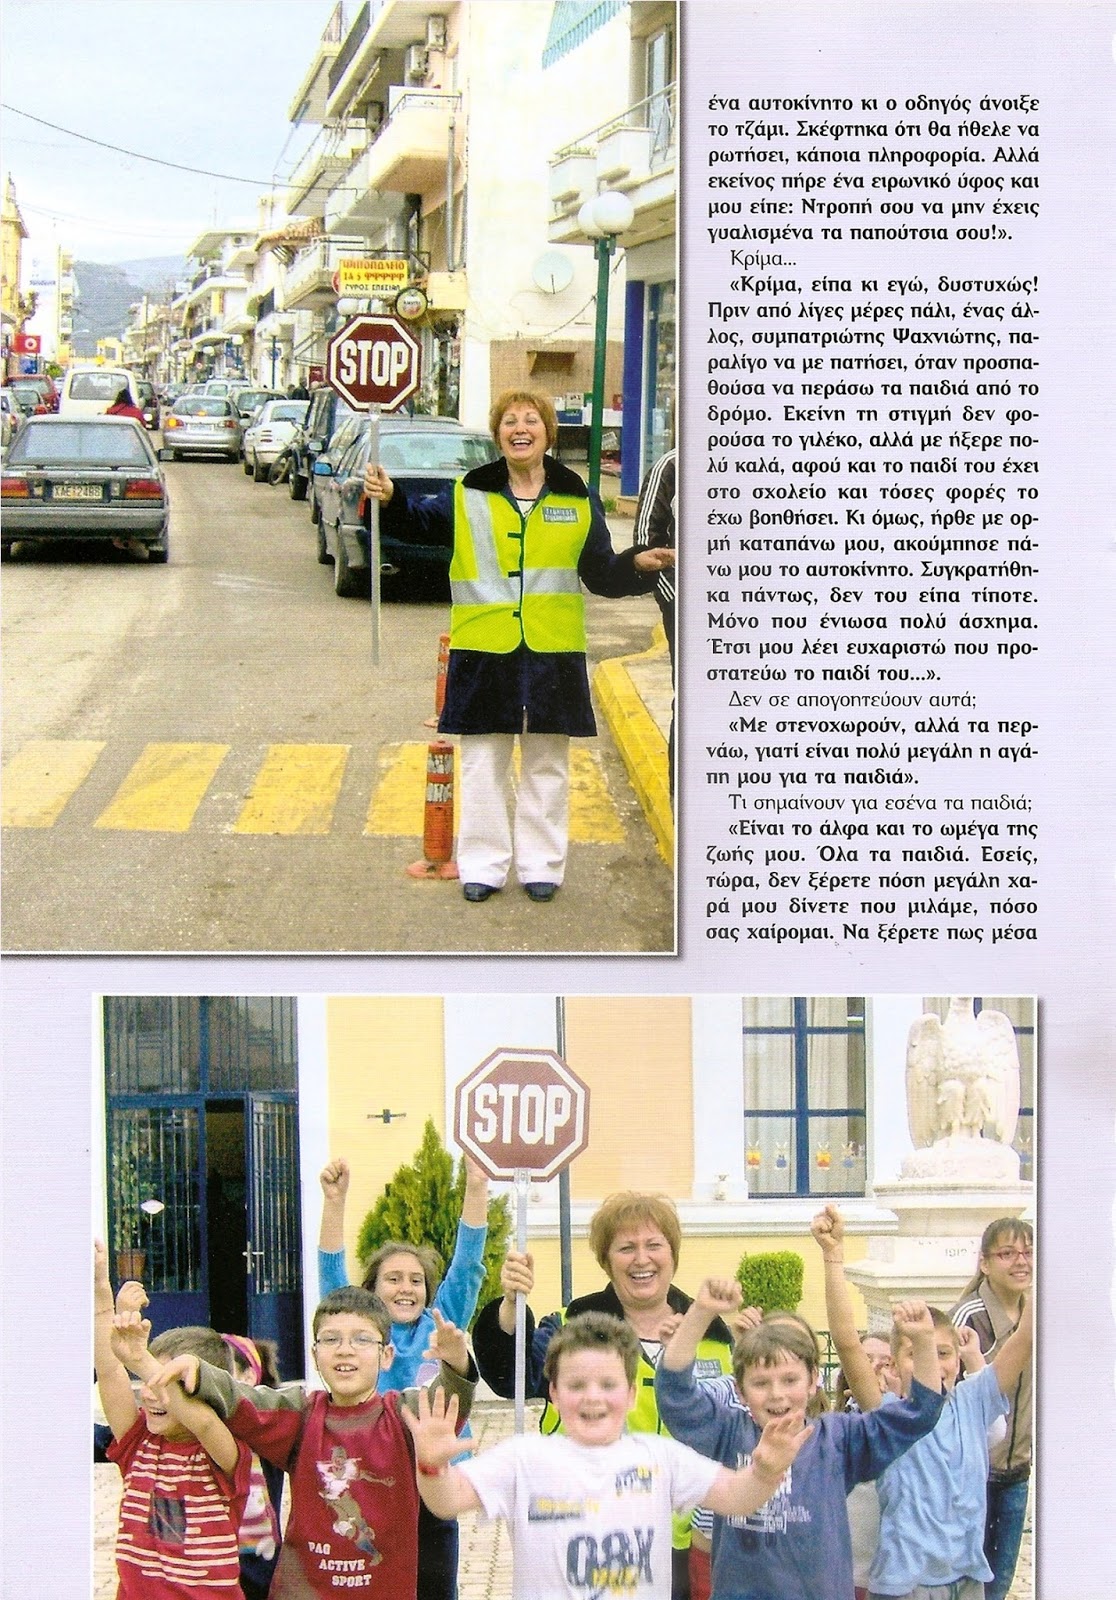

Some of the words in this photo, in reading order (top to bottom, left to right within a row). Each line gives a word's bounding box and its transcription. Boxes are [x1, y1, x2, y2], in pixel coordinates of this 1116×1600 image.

[708, 93, 741, 111] ένα
[748, 94, 854, 111] αυτοκίνητο
[860, 98, 878, 111] κι
[885, 98, 898, 111] ο
[904, 94, 972, 115] οδηγός
[979, 94, 1040, 115] άνοιξε
[708, 145, 790, 167] ρωτήσει,
[796, 145, 861, 163] κάποια
[867, 146, 986, 168] πληροφορία.
[992, 146, 1040, 163] Αλλά
[707, 172, 776, 192] εκείνος
[781, 171, 827, 193] πήρε
[832, 171, 865, 189] ένα
[871, 172, 951, 193] ειρωνικό
[957, 172, 1005, 193] ύφος
[1010, 176, 1040, 189] και
[706, 223, 814, 245] γυαλισμένα
[820, 228, 843, 240] τα
[849, 223, 949, 241] παπούτσια
[955, 223, 1013, 241] σου!».
[730, 249, 797, 271] Κρίμα...
[730, 275, 803, 297] «Κρίμα,
[811, 275, 853, 292] είπα
[860, 279, 879, 292] κι
[887, 275, 929, 296] εγώ,
[937, 275, 1038, 296] δυστυχώς!
[706, 327, 744, 348] λος,
[751, 327, 885, 349] συμπατριώτης
[892, 327, 1001, 348] Ψαχνιώτης,
[1008, 332, 1040, 344] πα-
[339, 339, 409, 387] STOP
[707, 353, 768, 374] ραλίγο
[773, 357, 796, 370] να
[802, 357, 824, 374] με
[829, 353, 908, 373] πατήσει,
[914, 353, 958, 370] όταν
[962, 357, 1040, 374] προσπα-
[707, 404, 772, 426] δρόμο.
[783, 404, 845, 422] Εκείνη
[856, 409, 878, 422] τη
[888, 404, 952, 426] στιγμή
[962, 405, 996, 422] δεν
[1005, 409, 1040, 426] φο-
[707, 430, 766, 452] ρούσα
[771, 435, 793, 447] το
[798, 430, 863, 452] γιλέκο,
[869, 430, 914, 448] αλλά
[920, 435, 943, 452] με
[948, 430, 1003, 452] ήξερε
[1008, 435, 1039, 448] πο-
[707, 487, 741, 500] στο
[752, 482, 827, 500] σχολείο
[837, 487, 868, 500] και
[879, 482, 935, 503] τόσες
[945, 482, 1006, 504] φορές
[1016, 487, 1039, 500] το
[707, 508, 743, 526] έχω
[749, 508, 839, 530] βοηθήσει.
[845, 509, 866, 526] Κι
[871, 508, 925, 530] όμως,
[930, 508, 976, 530] ήρθε
[982, 513, 1004, 530] με
[1009, 513, 1039, 530] ορ-
[707, 534, 731, 556] μή
[739, 534, 836, 551] καταπάνω
[844, 539, 885, 556] μου,
[893, 534, 1000, 556] ακούμπησε
[1007, 534, 1039, 552] πά-
[706, 590, 730, 603] κα
[740, 586, 818, 607] πάντως,
[829, 586, 864, 603] δεν
[874, 590, 907, 603] του
[918, 586, 961, 603] είπα
[971, 586, 1038, 603] τίποτε.
[706, 638, 751, 655] Έτσι
[759, 642, 794, 660] μου
[801, 638, 839, 655] λέει
[846, 638, 946, 660] ευχαριστώ
[953, 642, 989, 655] που
[996, 642, 1039, 660] προ-
[706, 664, 787, 681] στατεύω
[793, 668, 815, 681] το
[821, 664, 871, 681] παιδί
[877, 668, 941, 681] του...».
[728, 690, 763, 707] Δεν
[768, 695, 790, 707] σε
[796, 690, 923, 712] απογοητεύουν
[929, 690, 976, 710] αυτά;
[728, 716, 768, 733] «Με
[775, 716, 906, 737] στενοχωρούν,
[914, 716, 960, 733] αλλά
[967, 720, 990, 733] τα
[997, 720, 1039, 738] περ-
[705, 741, 749, 761] νάω,
[754, 742, 799, 763] γιατί
[805, 742, 850, 759] είναι
[855, 742, 901, 759] πολύ
[907, 742, 973, 763] μεγάλη
[979, 746, 991, 759] η
[997, 742, 1039, 763] αγά-
[705, 772, 730, 784] πη
[737, 772, 772, 789] μου
[778, 772, 808, 789] για
[814, 772, 837, 785] τα
[843, 767, 919, 785] παιδιά».
[728, 793, 747, 810] Τι
[753, 793, 846, 815] σημαίνουν
[851, 798, 878, 815] για
[884, 793, 937, 811] εσένα
[943, 798, 964, 811] τα
[970, 793, 1032, 811] παιδιά;
[728, 819, 785, 836] «Είναι
[791, 823, 813, 836] το
[819, 819, 870, 841] άλφα
[875, 823, 905, 836] και
[911, 823, 933, 836] το
[940, 819, 1000, 841] ωμέγα
[1006, 823, 1039, 840] της
[706, 845, 755, 866] ζωής
[765, 849, 806, 867] μου.
[816, 845, 859, 862] Όλα
[869, 849, 892, 862] τα
[901, 845, 970, 862] παιδιά.
[980, 845, 1038, 866] Εσείς,
[706, 896, 731, 918] ρά
[742, 901, 777, 918] μου
[788, 897, 850, 914] δίνετε
[860, 901, 896, 914] που
[908, 897, 978, 918] μιλάμε,
[989, 897, 1038, 914] πόσο
[705, 927, 740, 943] σας
[746, 923, 834, 944] χαίρομαι.
[842, 923, 870, 940] Να
[877, 923, 940, 944] ξέρετε
[946, 927, 984, 944] πως
[992, 923, 1038, 945] μέσα
[474, 1083, 572, 1145] STOP
[318, 1558, 366, 1572] ACTIVE
[331, 1574, 373, 1588] SPORT
